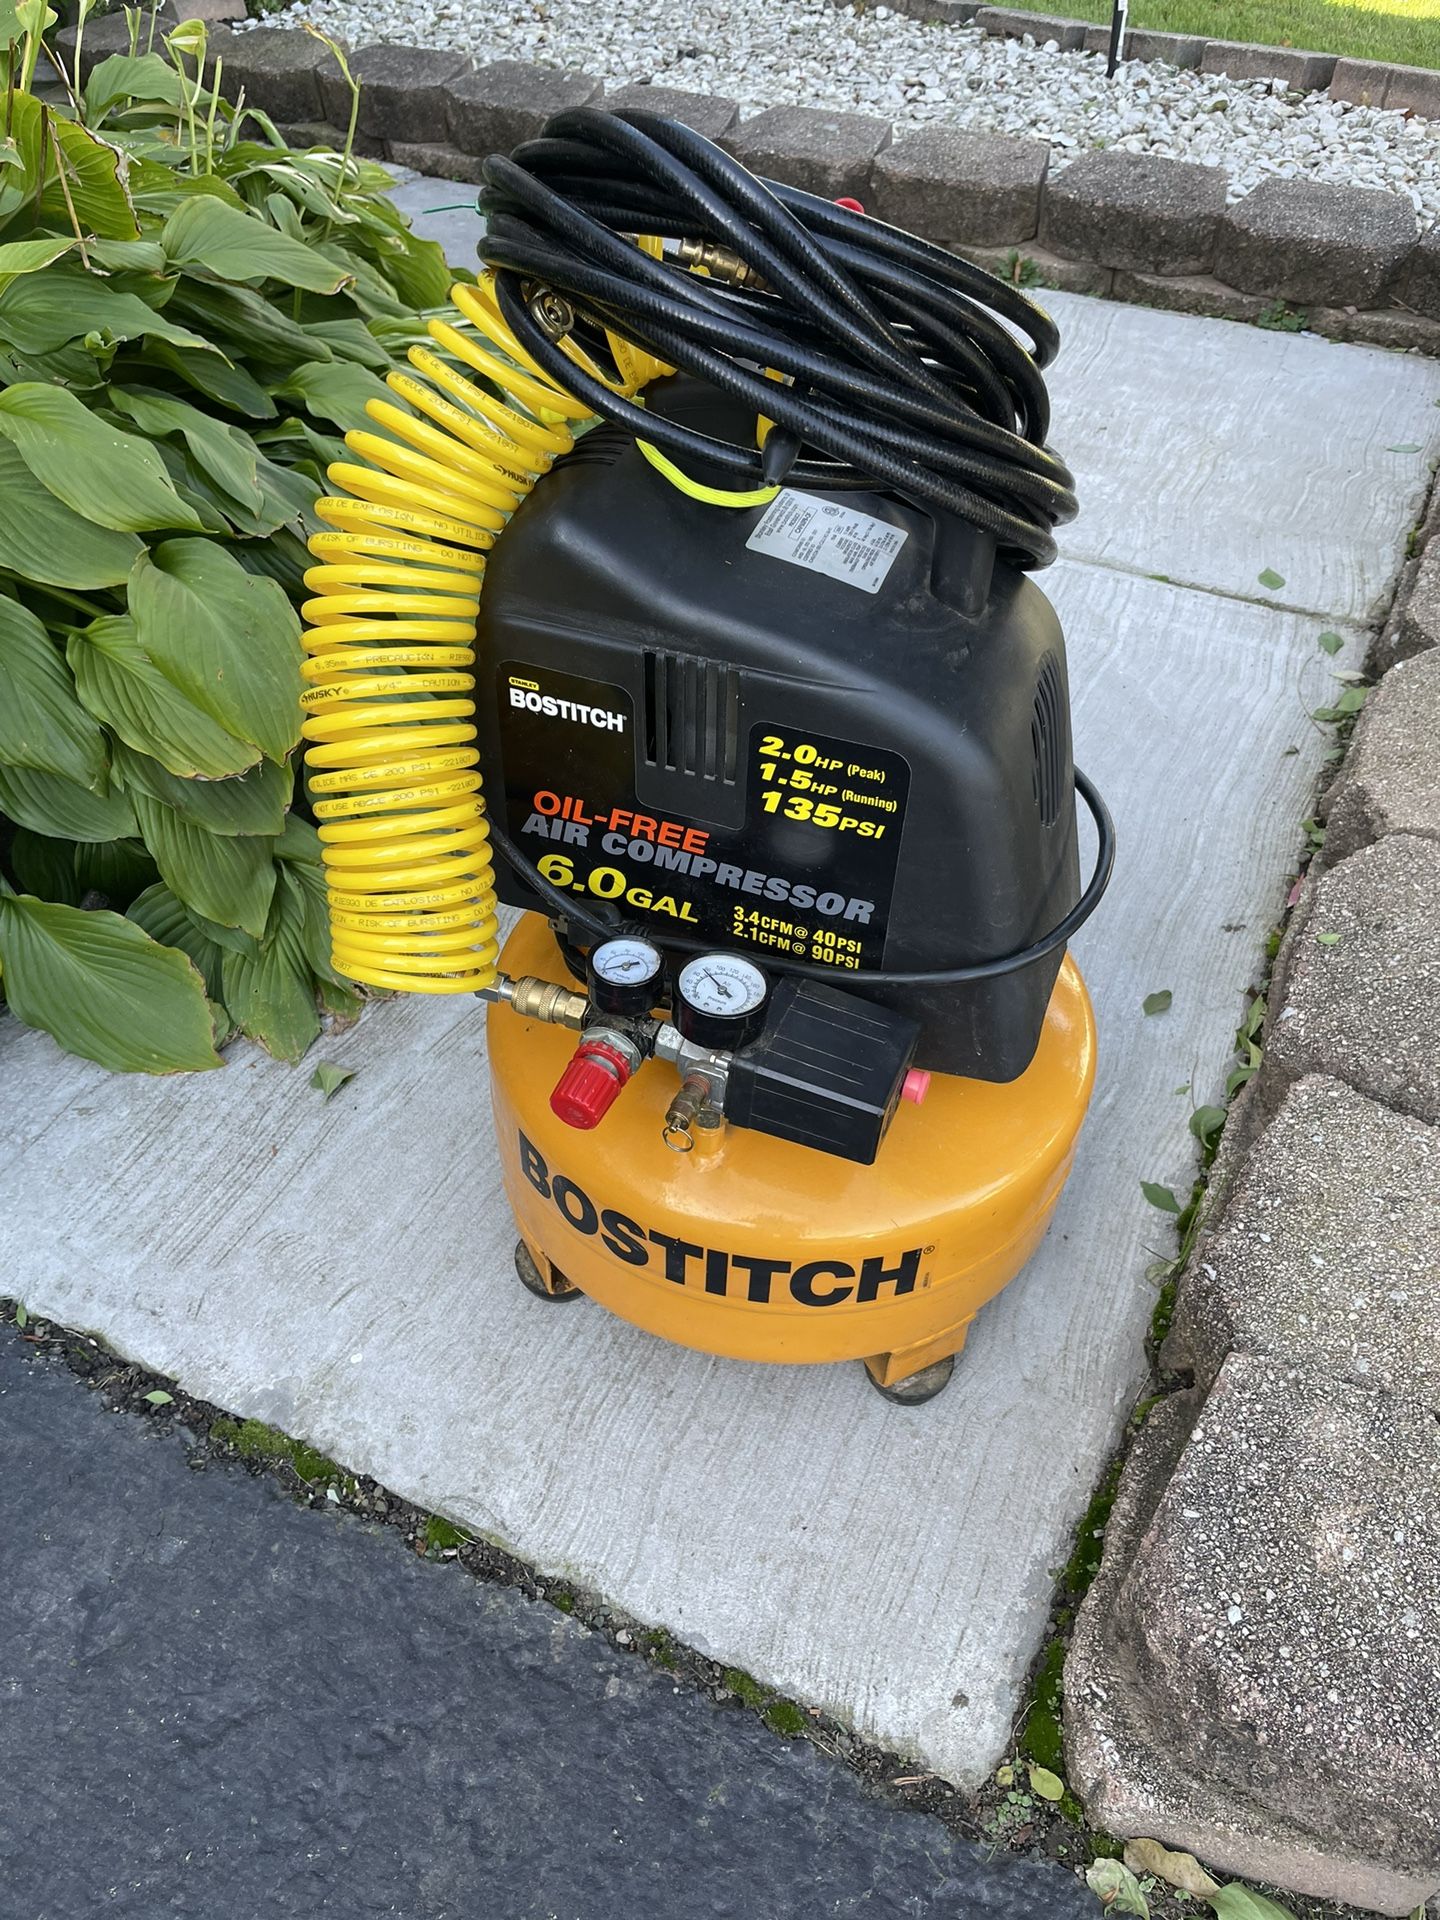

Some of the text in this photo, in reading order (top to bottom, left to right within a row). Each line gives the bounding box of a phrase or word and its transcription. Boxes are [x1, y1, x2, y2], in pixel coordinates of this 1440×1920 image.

[445, 369, 464, 386] 200
[467, 382, 487, 401] PSI
[428, 393, 449, 410] 200
[451, 406, 471, 426] PSI
[336, 500, 347, 509] DE
[346, 535, 359, 543] OF
[440, 549, 453, 559] DO
[308, 686, 342, 702] HUSKY
[422, 679, 460, 687] CAUTION
[511, 678, 537, 689] STANLEY
[509, 687, 624, 733] BOSTITCH
[385, 766, 405, 776] 200
[411, 762, 432, 772] PSI
[758, 735, 886, 784] 2.0HP (Peak)
[332, 802, 349, 810] USE
[392, 792, 415, 802] 200
[420, 787, 439, 797] PSI
[759, 762, 897, 813] 1.5HP (Running)
[533, 790, 710, 856] OIL-FREE
[761, 790, 886, 839] 135PSI
[520, 813, 876, 925] AIR COMPRESSOR
[365, 899, 378, 907] DE
[536, 854, 699, 924] 6.0GAL
[358, 918, 380, 928] RISK
[407, 913, 460, 927] BURSTING
[812, 929, 862, 954] 40PSI
[811, 945, 860, 969] 90PSI
[518, 1128, 922, 1307] BOSTITCH
